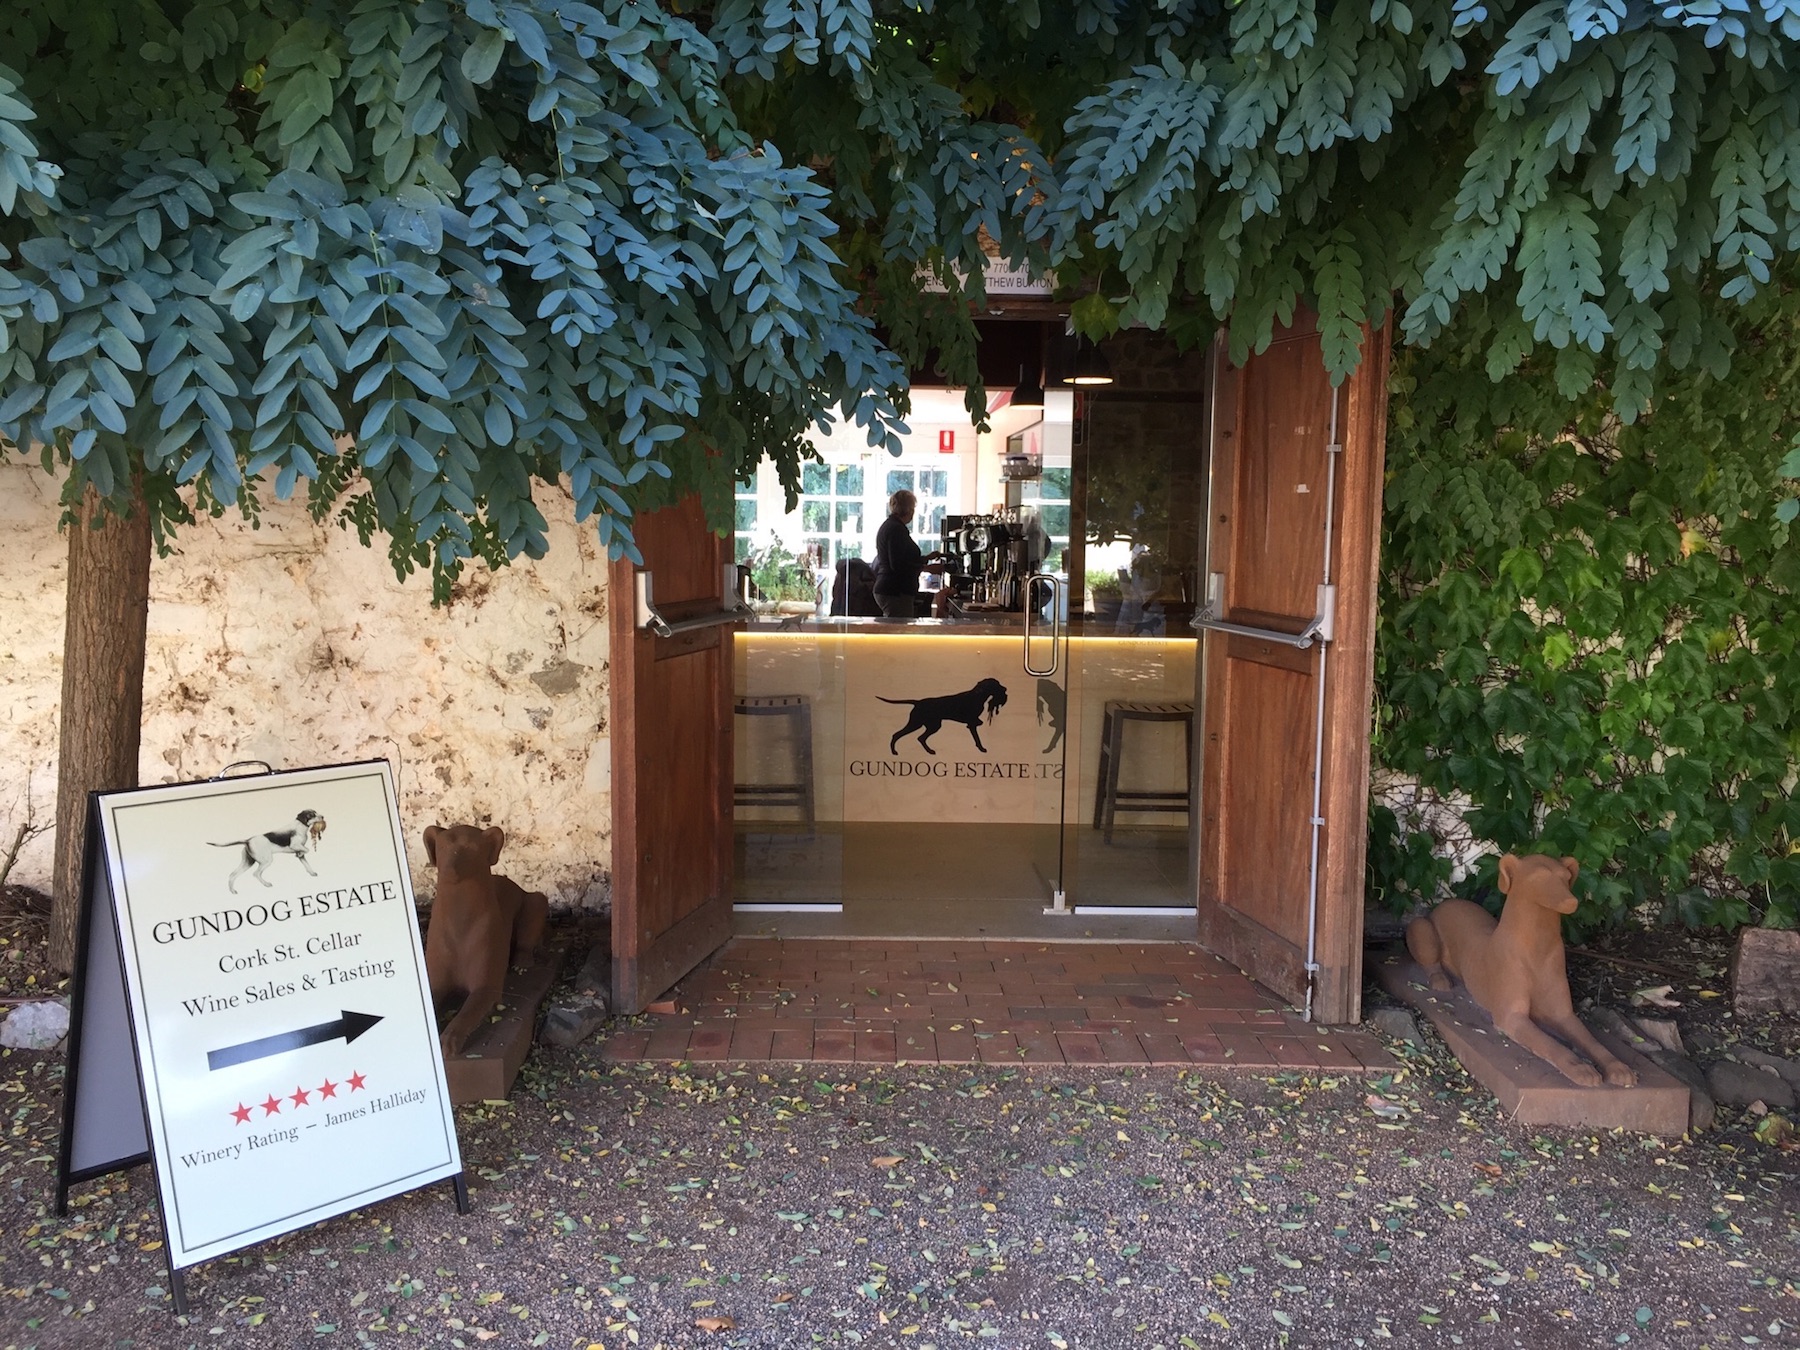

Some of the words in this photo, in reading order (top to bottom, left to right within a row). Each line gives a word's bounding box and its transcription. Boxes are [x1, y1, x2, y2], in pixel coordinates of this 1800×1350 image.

[984, 277, 1015, 288] THEW
[850, 760, 948, 777] GUNDOG
[954, 762, 1030, 779] ESTATE
[152, 900, 292, 944] GUNDOG
[297, 880, 397, 917] ESTATE
[219, 949, 269, 973] Cork
[274, 944, 300, 963] St.
[306, 932, 362, 955] Cellar
[182, 994, 240, 1018] Wine
[245, 981, 295, 1005] Sales
[302, 974, 317, 991] &
[321, 959, 396, 986] Tasting
[180, 1142, 243, 1169] Winery
[247, 1126, 300, 1151] Rating
[324, 1107, 366, 1128] James
[370, 1088, 427, 1114] Halliday
